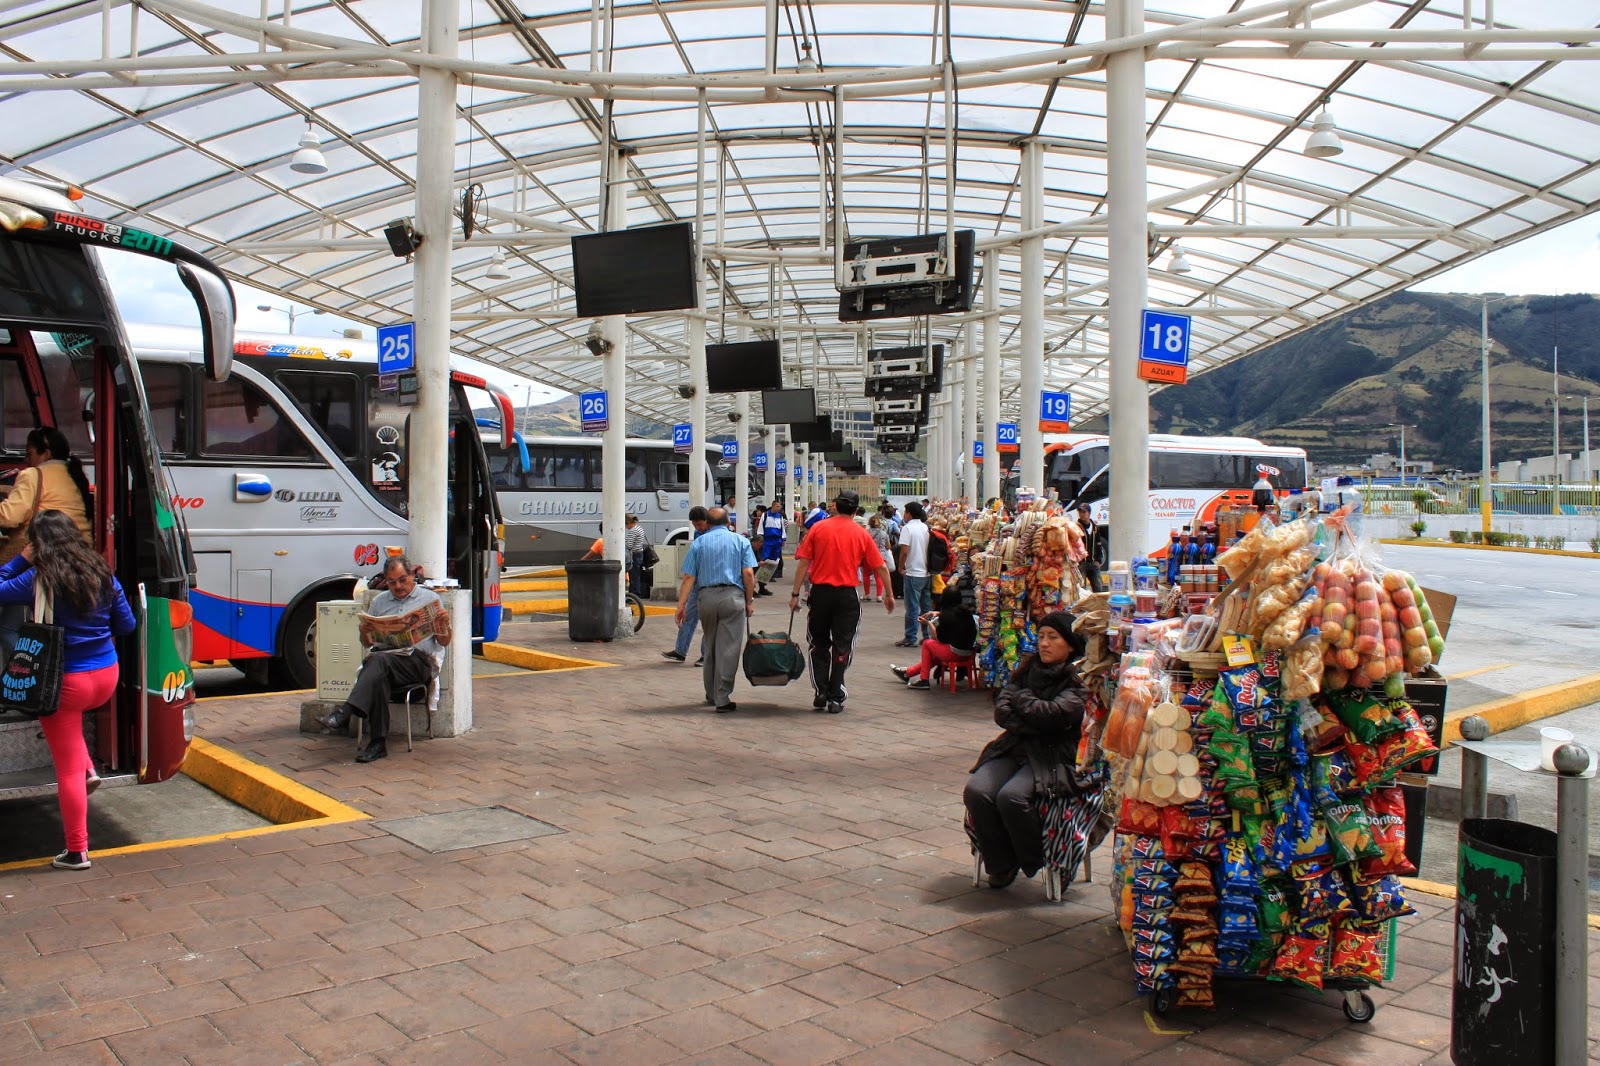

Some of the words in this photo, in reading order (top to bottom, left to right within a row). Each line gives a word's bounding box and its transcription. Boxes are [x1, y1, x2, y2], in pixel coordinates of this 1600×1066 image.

[54, 211, 103, 232] HINO
[54, 222, 120, 244] TRUCKS
[121, 228, 173, 256] 2011
[1148, 323, 1183, 353] 18
[382, 334, 410, 363] 25
[1150, 367, 1175, 377] AZUAY
[584, 398, 605, 415] 26
[1045, 398, 1066, 415] 19
[676, 429, 690, 441] 27
[1000, 428, 1014, 440] 20
[725, 445, 737, 454] 28
[756, 456, 766, 464] 29
[518, 500, 648, 516] CHIMBOZO
[1151, 498, 1196, 510] COACTUR
[29, 639, 44, 656] 87
[162, 669, 186, 703] 02
[3, 687, 27, 702] BEACH
